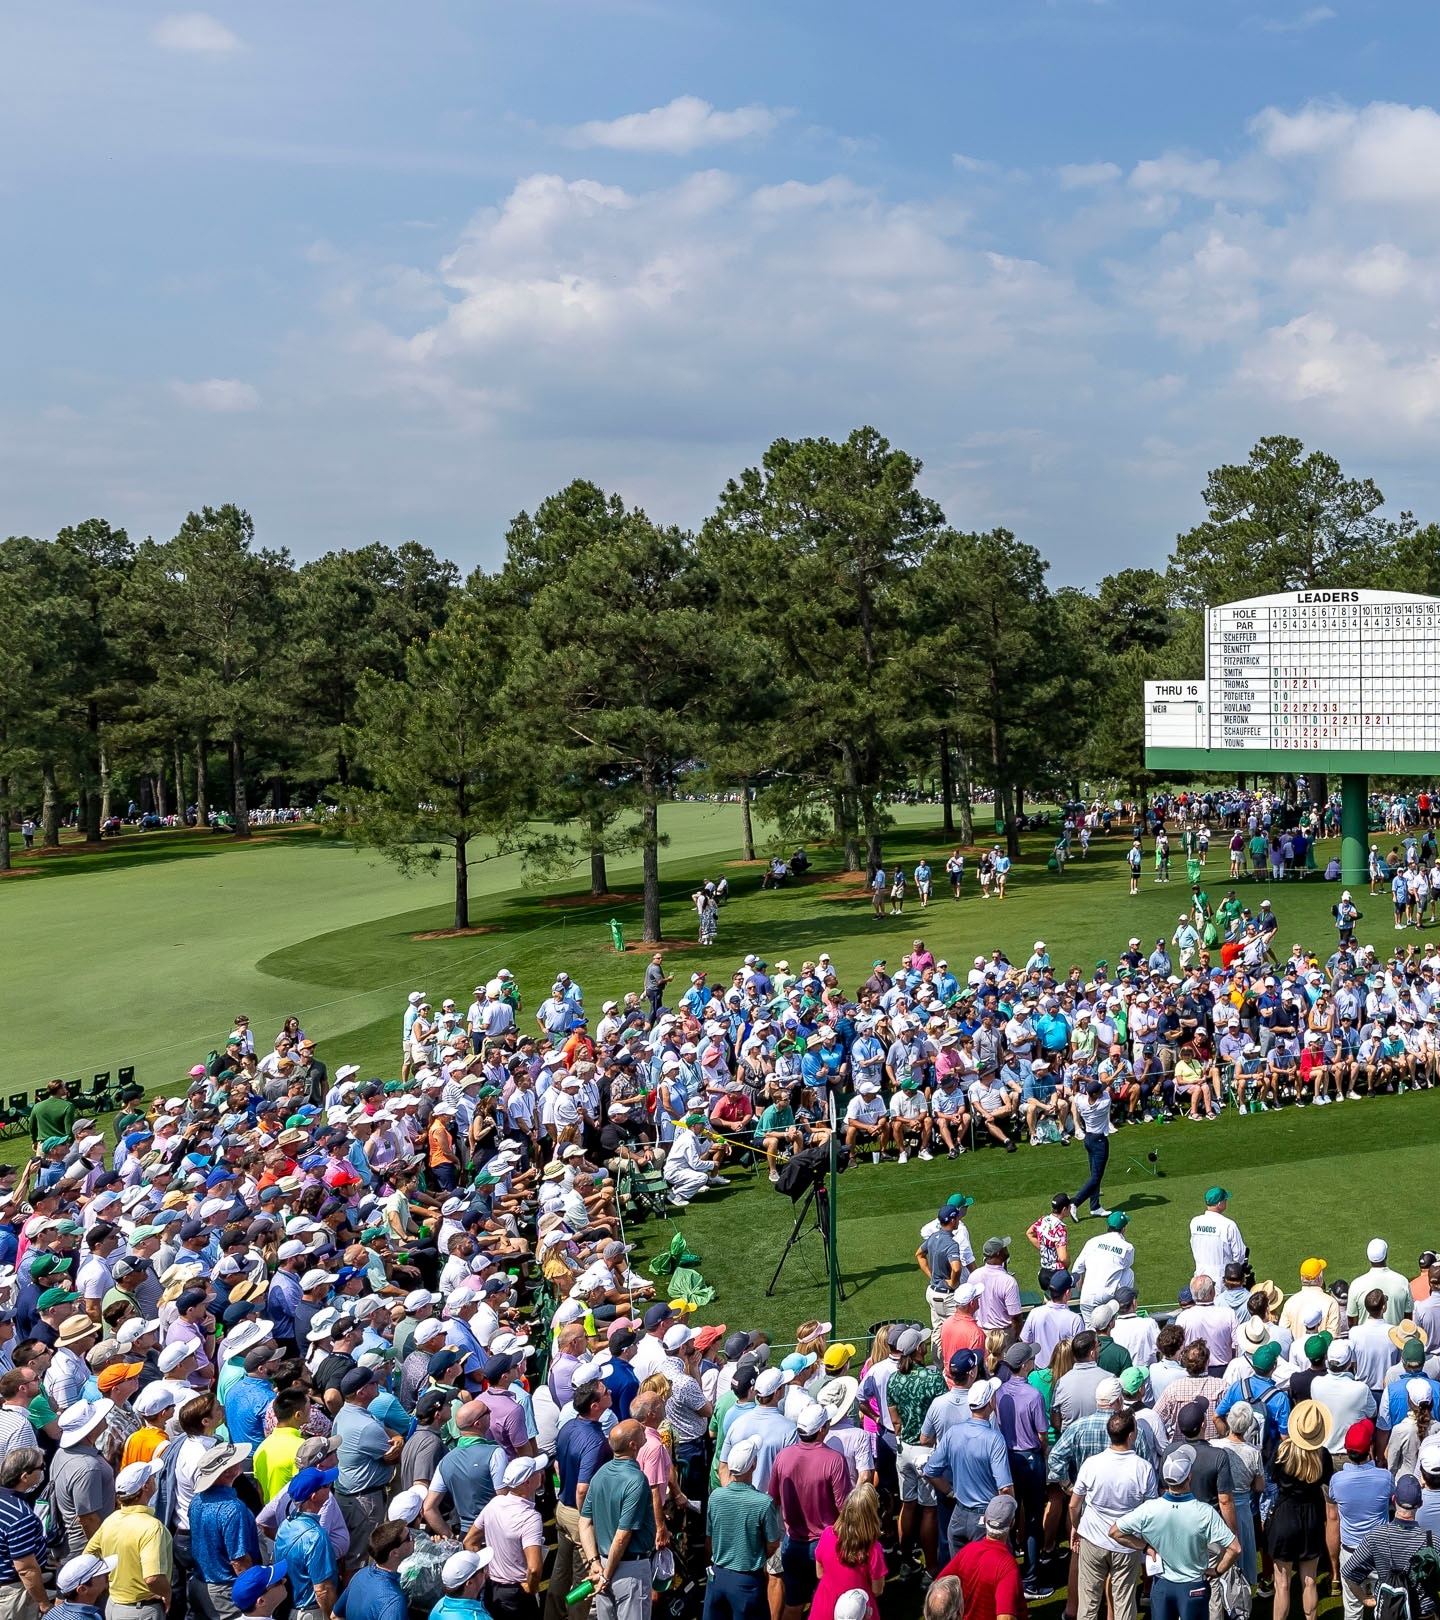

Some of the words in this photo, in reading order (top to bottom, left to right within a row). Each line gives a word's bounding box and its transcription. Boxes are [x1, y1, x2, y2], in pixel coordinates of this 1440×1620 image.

[1297, 592, 1359, 603] LEADERS
[1232, 610, 1256, 618] HOLE
[1283, 609, 1287, 617] 2
[1292, 609, 1297, 617] 3
[1312, 608, 1316, 617] 5
[1322, 608, 1326, 616] 6
[1332, 608, 1336, 616] 7
[1342, 607, 1346, 616] 8
[1352, 607, 1357, 616] 9
[1363, 606, 1372, 615] 10
[1384, 606, 1391, 614] 12
[1394, 605, 1403, 614] 13
[1415, 605, 1423, 614] 15
[1426, 605, 1434, 613] 16
[1283, 621, 1287, 629] 5
[1302, 620, 1307, 628] 3
[1322, 620, 1327, 628] 3
[1342, 619, 1346, 628] 5
[1385, 618, 1390, 627] 3
[1396, 618, 1400, 626] 5
[1417, 617, 1421, 626] 5
[1427, 617, 1432, 626] 3
[1224, 633, 1256, 641] SCHEFFLER
[1224, 645, 1250, 653] BENNETT
[1224, 657, 1260, 665] FITZPATRICK
[1274, 668, 1278, 676] 0
[1225, 680, 1248, 688] THOMAS
[1274, 680, 1278, 688] 0
[1293, 680, 1298, 688] 2
[1303, 680, 1308, 688] 2
[1156, 686, 1182, 695] THRU
[1187, 686, 1198, 695] 16
[1224, 692, 1254, 700] POTGIETER
[1283, 692, 1288, 700] 0
[1153, 705, 1167, 713] WEIR
[1224, 704, 1251, 712] HOVLAND
[1274, 704, 1278, 712] 0
[1284, 704, 1288, 712] 2
[1294, 704, 1298, 712] 2
[1303, 704, 1308, 712] 2
[1313, 704, 1318, 712] 2
[1323, 704, 1328, 712] 3
[1332, 704, 1337, 712] 3
[1224, 716, 1248, 724] MERONK
[1284, 716, 1288, 724] 0
[1313, 716, 1318, 724] 0
[1333, 716, 1338, 725] 2
[1343, 716, 1348, 725] 2
[1365, 716, 1370, 724] 2
[1376, 716, 1380, 724] 2
[1224, 727, 1261, 735] SCHAUFFELE
[1274, 728, 1278, 736] 0
[1304, 728, 1308, 736] 2
[1313, 728, 1318, 736] 2
[1323, 728, 1328, 737] 2
[1224, 739, 1244, 747] YOUNG
[1284, 740, 1288, 748] 2
[1294, 740, 1298, 748] 3
[1304, 740, 1308, 748] 3
[1314, 740, 1318, 748] 3
[1196, 1225, 1216, 1234] WOODS
